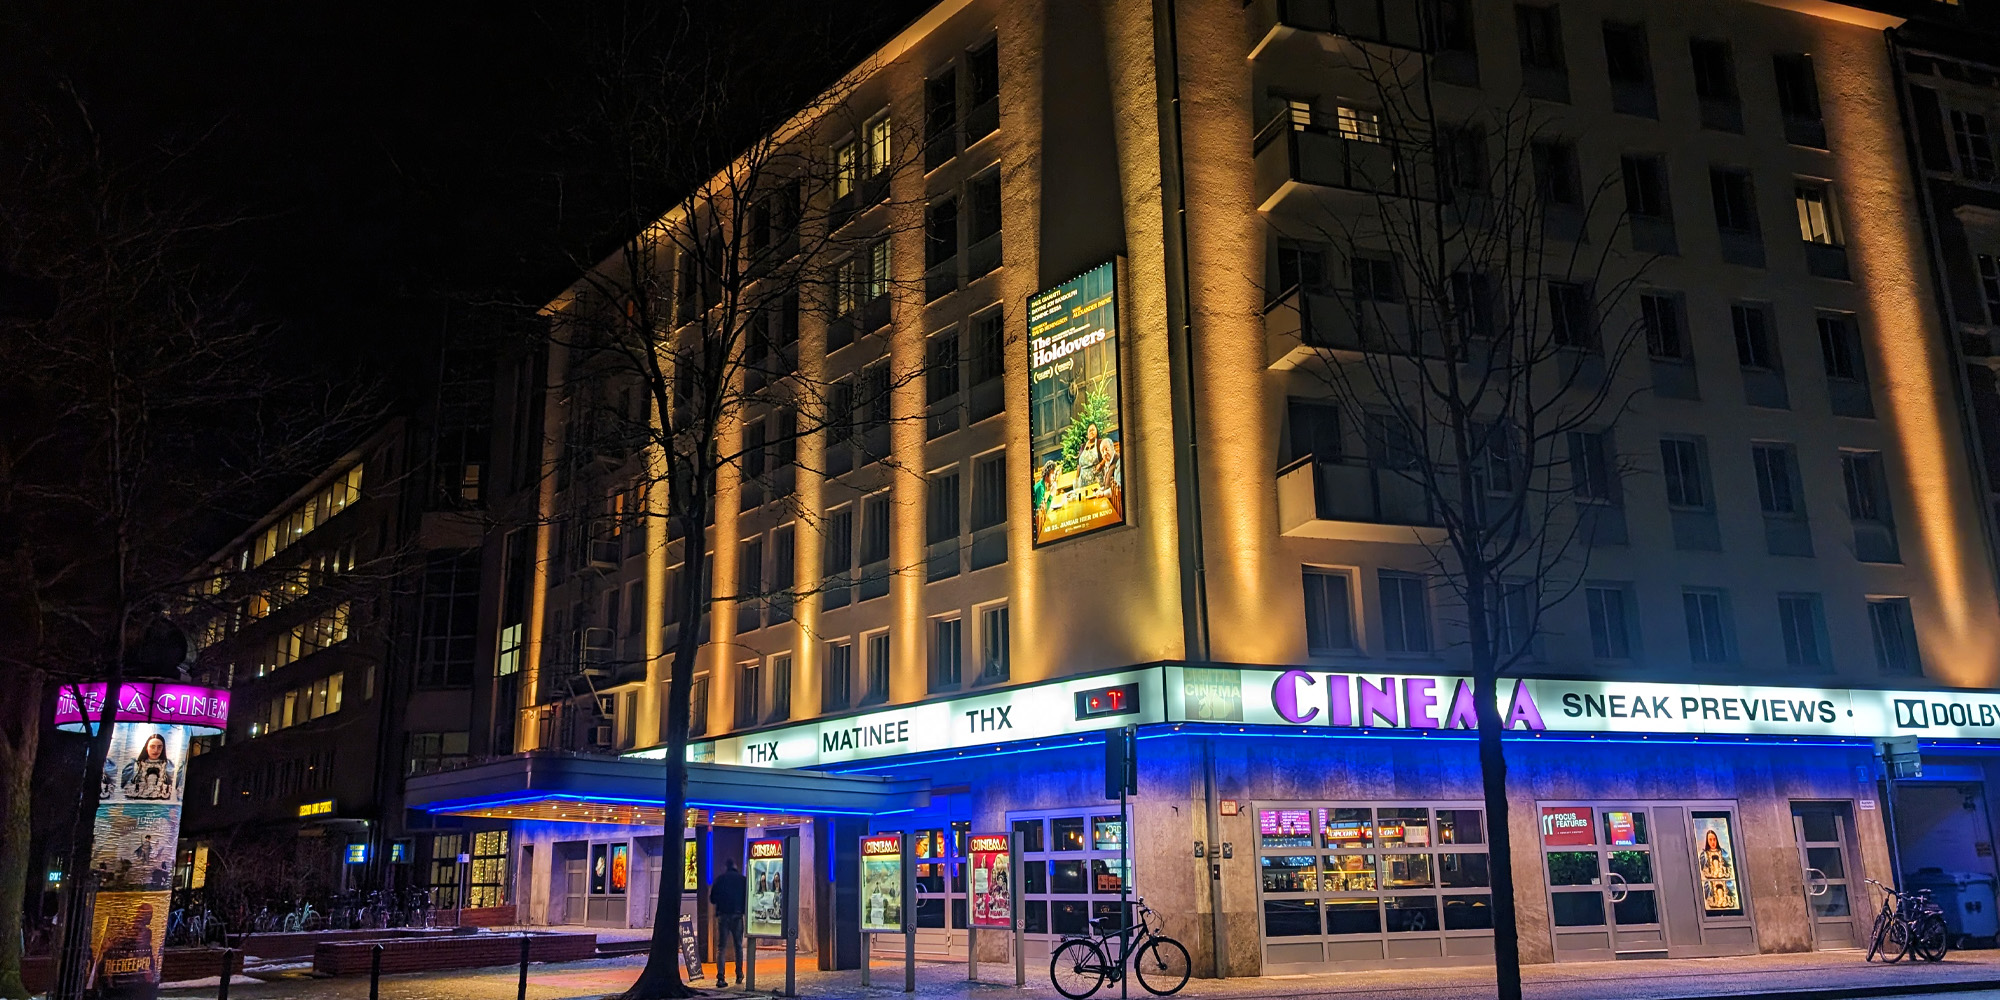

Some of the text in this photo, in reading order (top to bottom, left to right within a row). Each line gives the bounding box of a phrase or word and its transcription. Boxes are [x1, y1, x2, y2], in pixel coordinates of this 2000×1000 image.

[1032, 336, 1051, 351] The
[1033, 328, 1106, 369] Holdovers
[1185, 683, 1242, 698] CINEMA
[1271, 669, 1547, 730] CINEMA
[1562, 692, 1837, 723] SNEAK PREVIEWS
[747, 704, 1014, 764] THX MATINEE THX
[1554, 812, 1577, 821] FOCUS
[1556, 819, 1588, 828] FEATURES
[751, 843, 783, 857] CINEMA
[864, 840, 900, 854] CINEMA
[971, 838, 1008, 851] CINEMA
